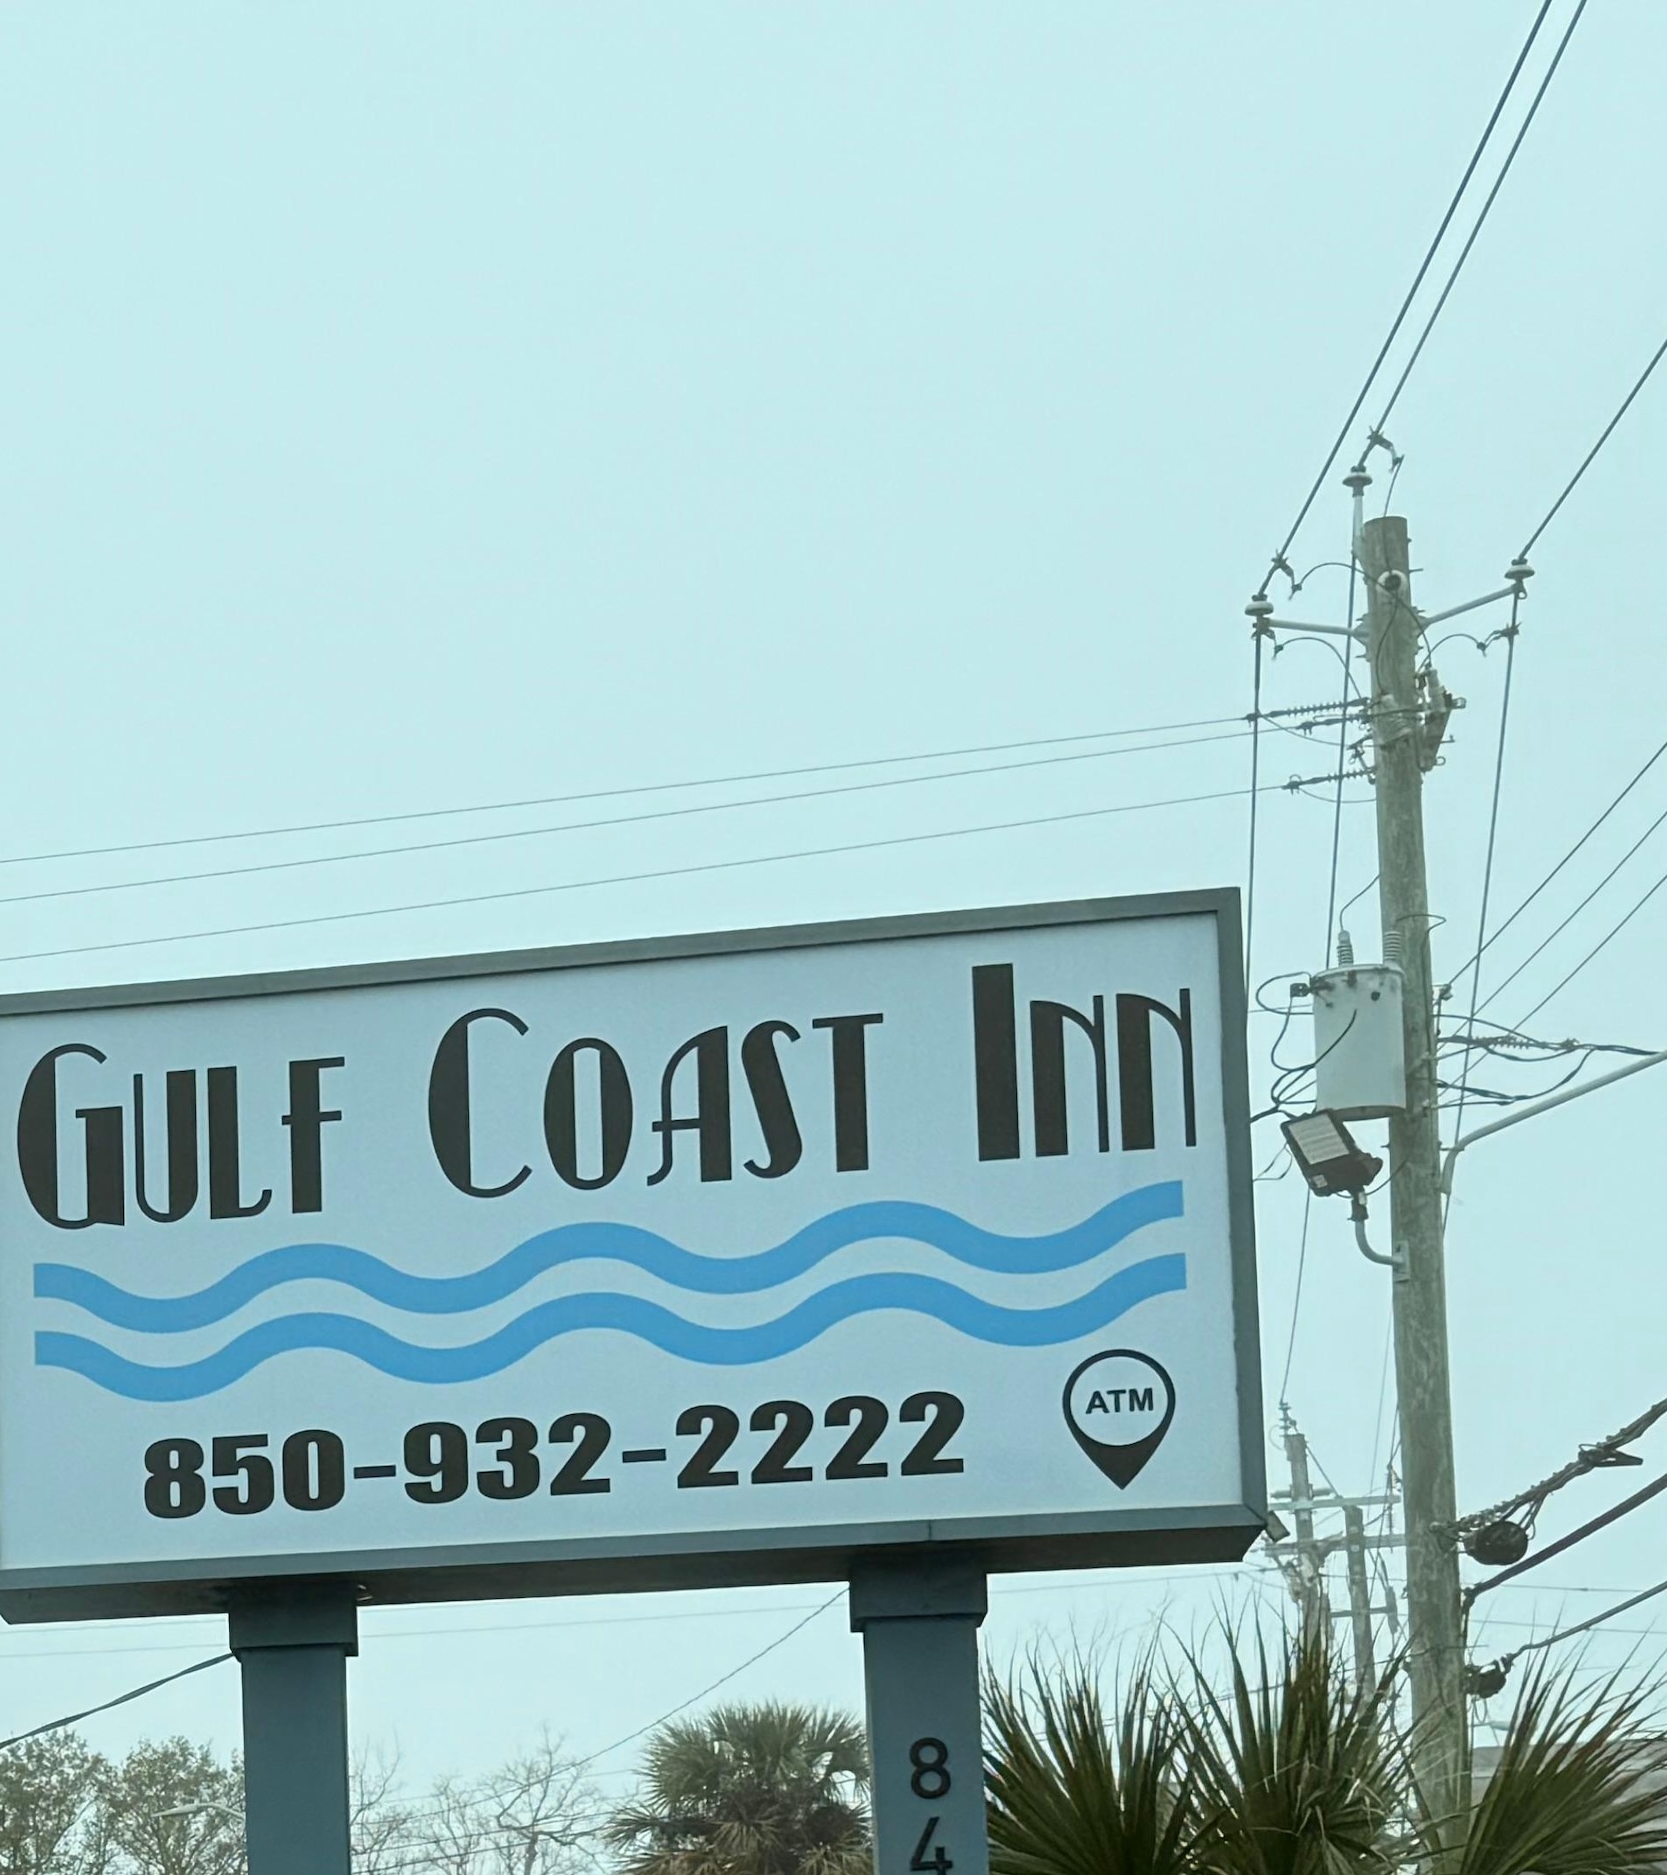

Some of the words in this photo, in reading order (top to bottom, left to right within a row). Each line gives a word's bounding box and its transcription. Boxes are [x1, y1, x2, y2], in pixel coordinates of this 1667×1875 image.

[17, 1044, 345, 1230] GULF
[429, 1007, 884, 1199] COAST
[972, 962, 1197, 1162] INN
[144, 1390, 965, 1519] 850-932-2222
[1086, 1388, 1154, 1415] ATM
